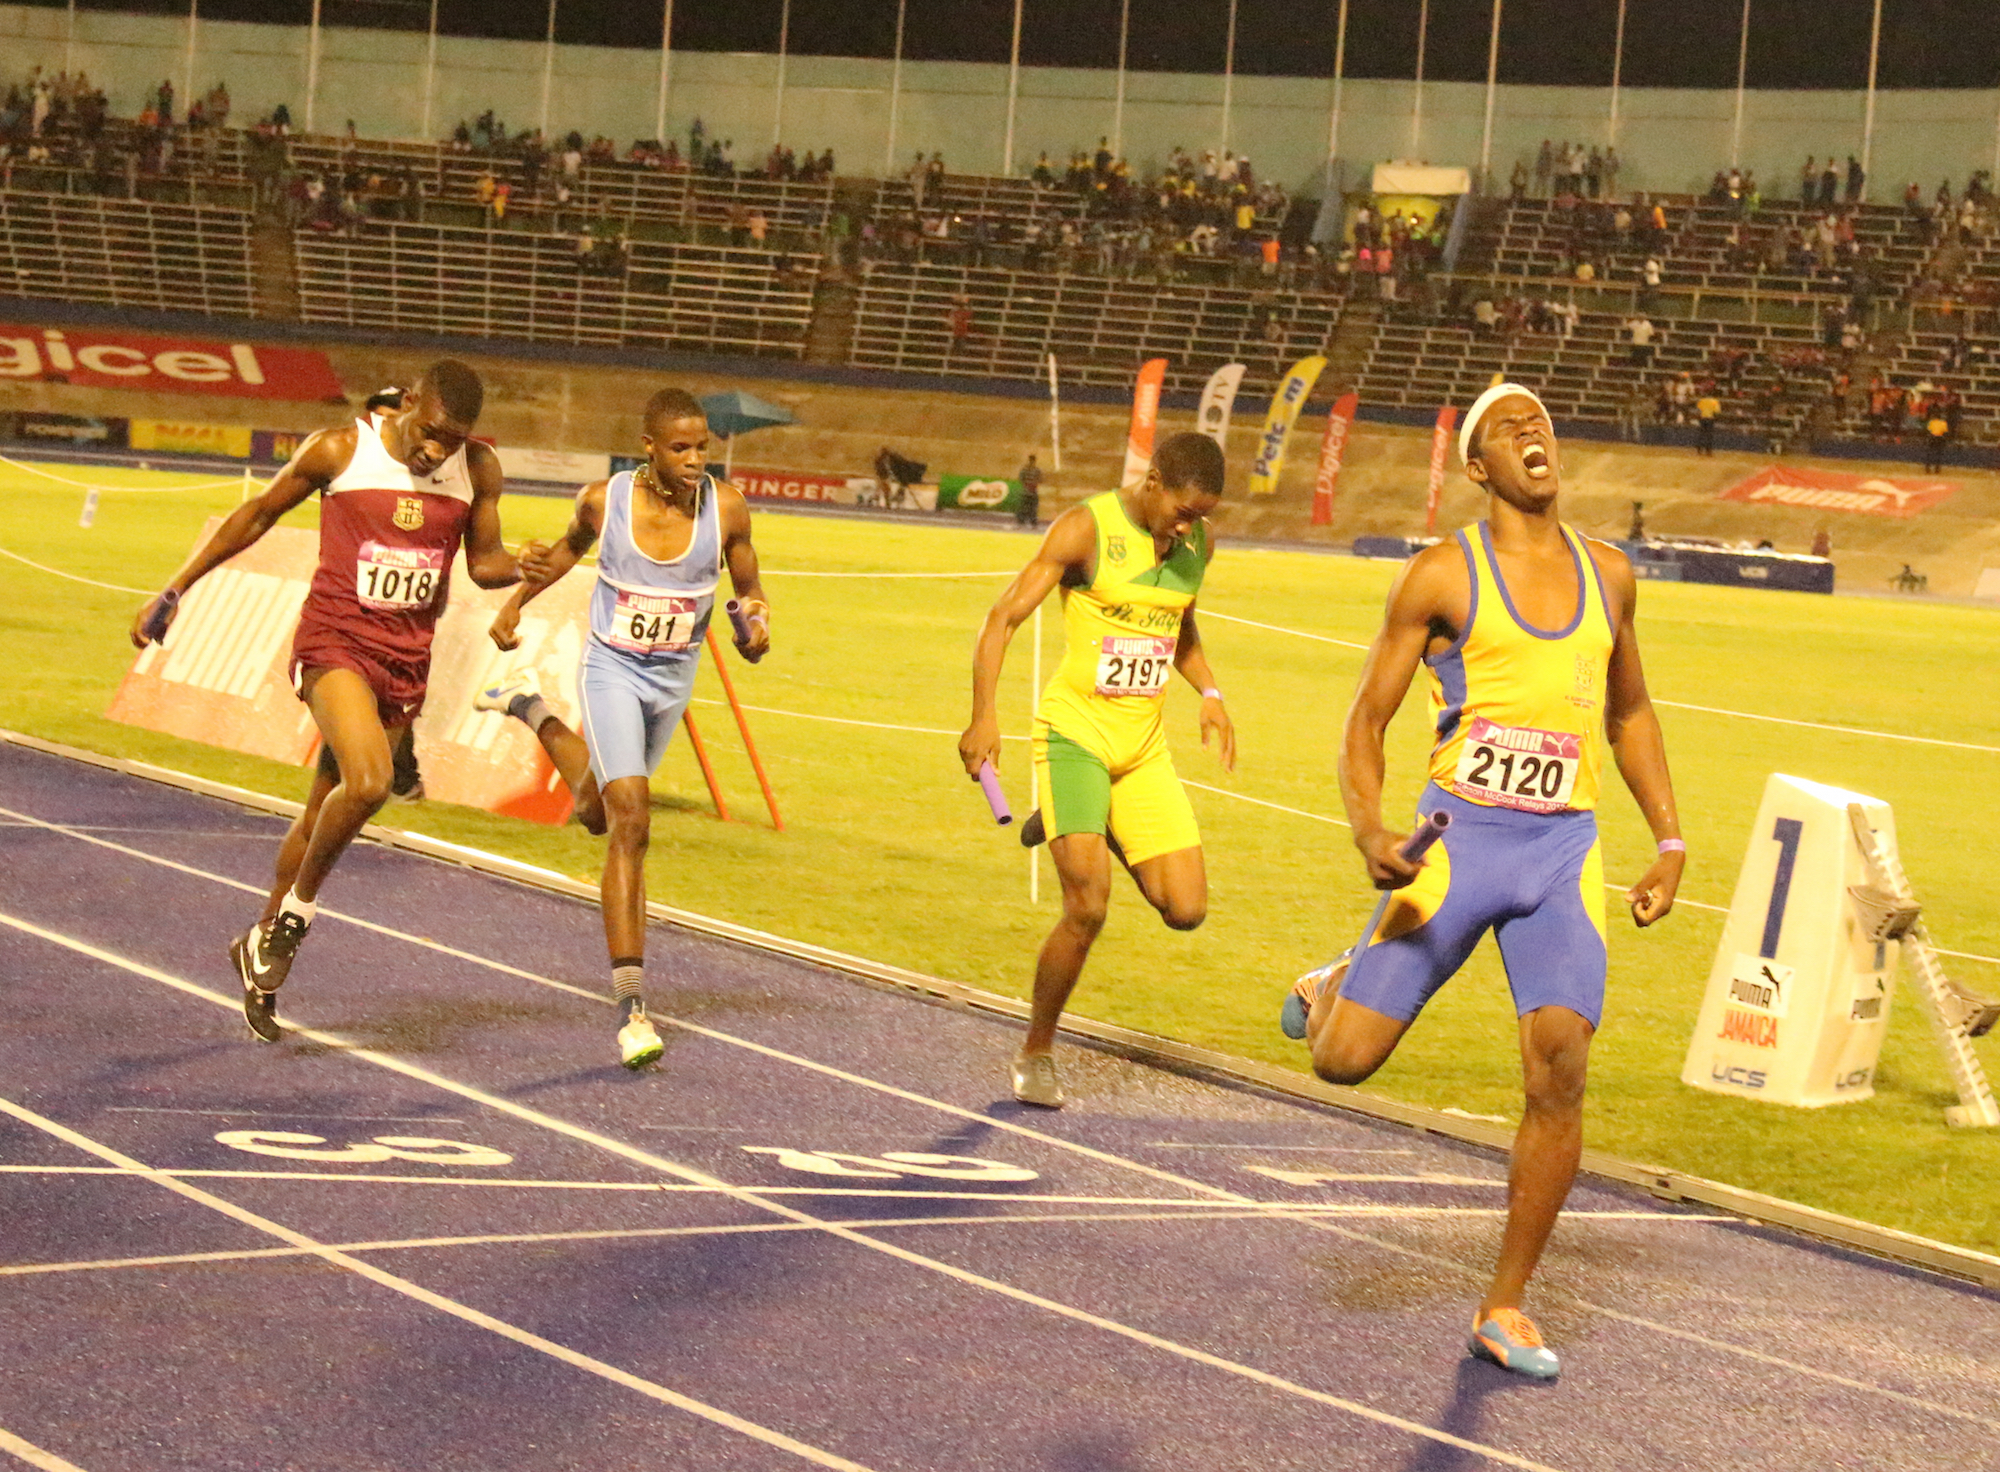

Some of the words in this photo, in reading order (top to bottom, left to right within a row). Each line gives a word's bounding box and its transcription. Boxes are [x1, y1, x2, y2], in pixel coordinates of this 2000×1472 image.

[1315, 414, 1348, 494] Digicel
[731, 476, 835, 501] SINGER
[371, 545, 418, 568] PUMA
[367, 566, 432, 602] 1018
[627, 594, 671, 613] PUMA
[630, 613, 676, 642] 641
[1113, 638, 1155, 656] PUMA
[1105, 657, 1167, 687] 2197
[1481, 724, 1545, 753] PUMA
[1467, 746, 1563, 799] 2120
[1484, 789, 1517, 806] McCook
[1518, 798, 1545, 812] Relays
[1758, 817, 1803, 959] 1
[1729, 978, 1772, 1009] PUMA
[1717, 1009, 1778, 1049] JAMAICA
[1711, 1063, 1767, 1088] UCS
[214, 1130, 514, 1165] 3
[741, 1146, 1040, 1182] 2
